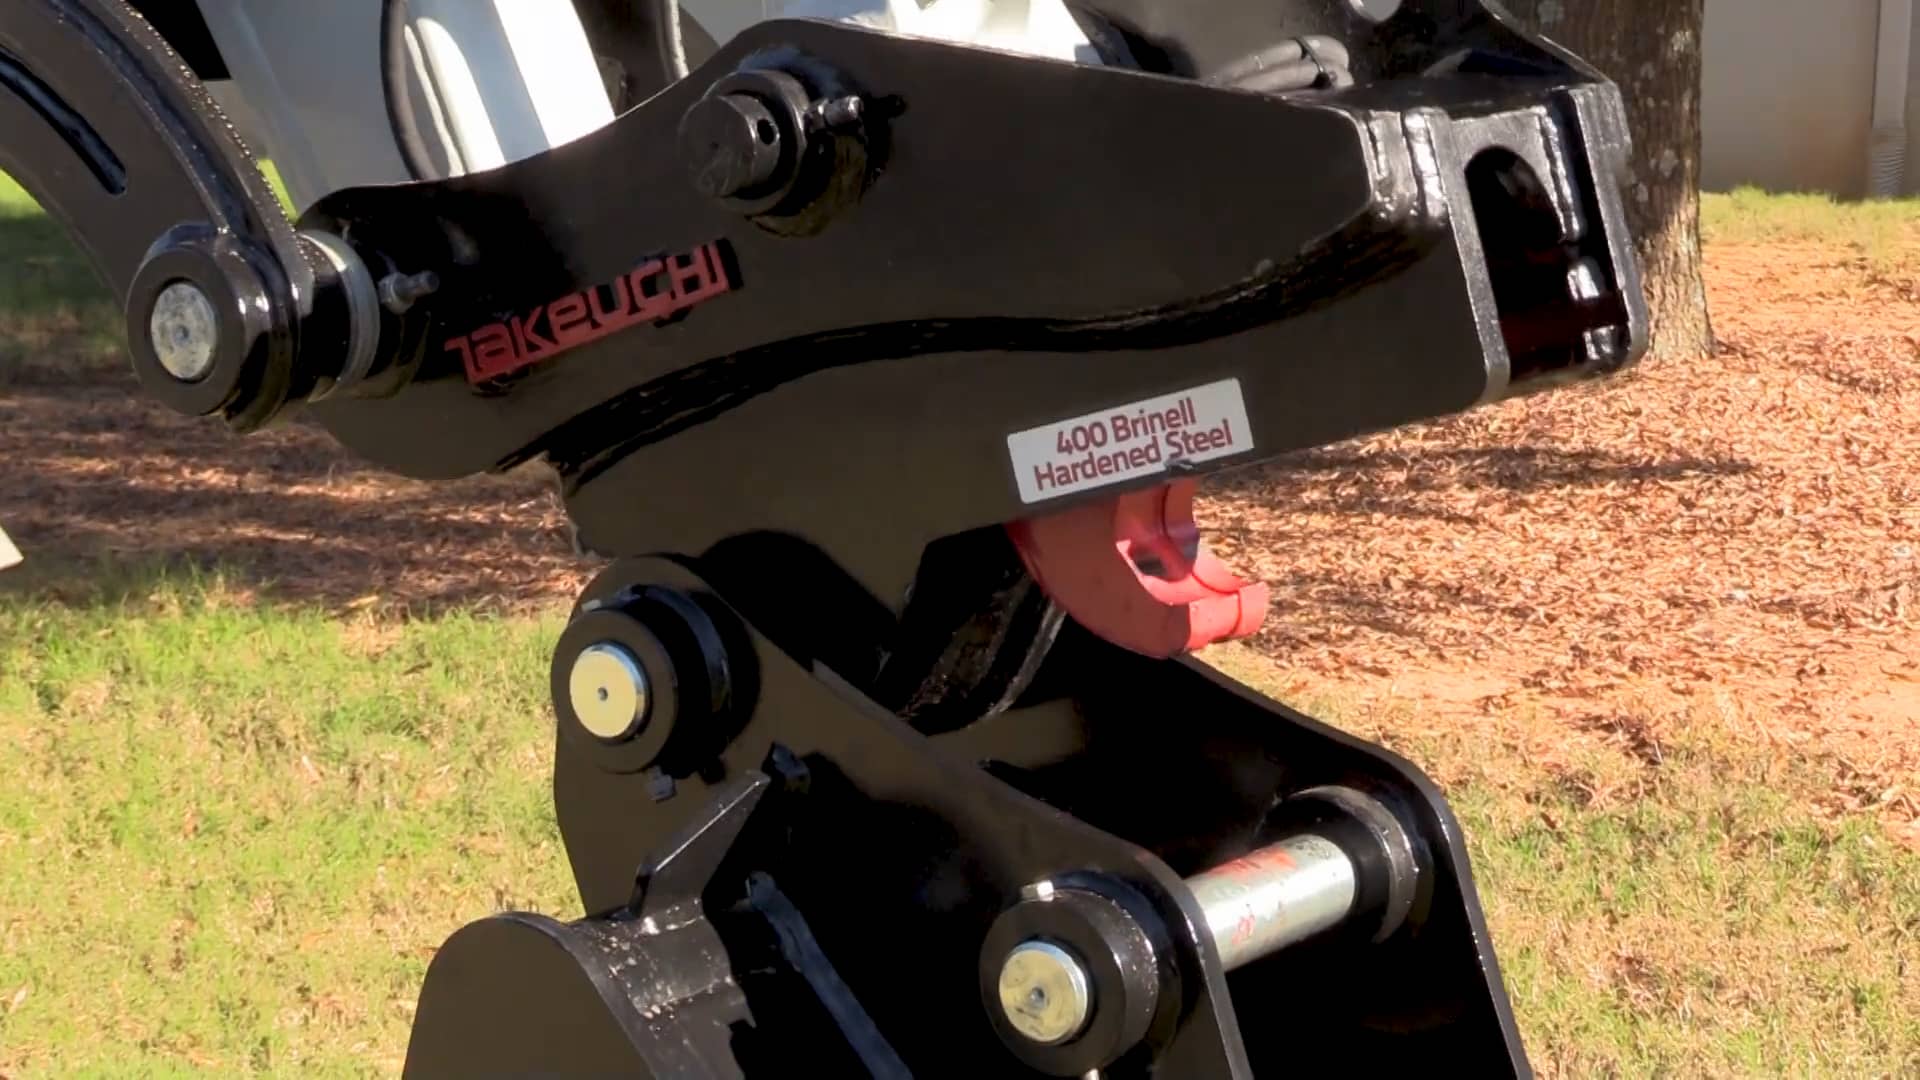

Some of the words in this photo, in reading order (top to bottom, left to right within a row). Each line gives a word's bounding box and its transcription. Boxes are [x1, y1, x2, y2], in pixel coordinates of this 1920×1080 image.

[1033, 436, 1162, 491] Hardened
[1165, 418, 1233, 460] Steel
[1056, 421, 1108, 456] 400
[1110, 397, 1197, 443] Brinell
